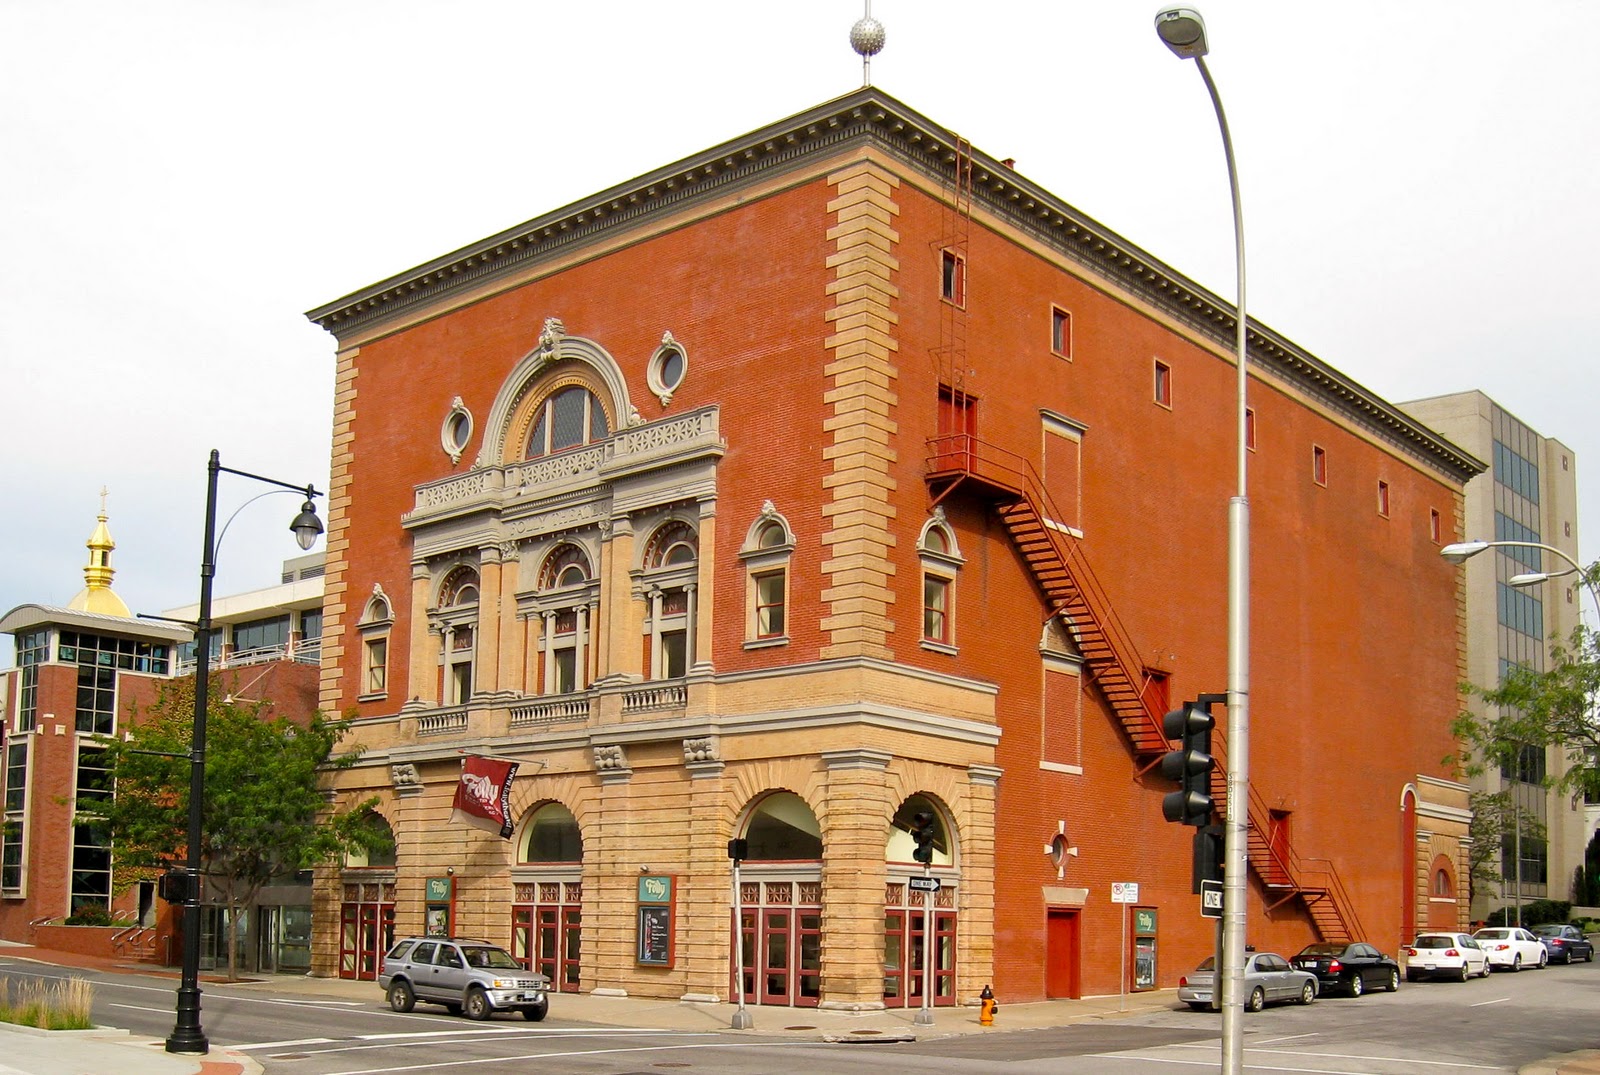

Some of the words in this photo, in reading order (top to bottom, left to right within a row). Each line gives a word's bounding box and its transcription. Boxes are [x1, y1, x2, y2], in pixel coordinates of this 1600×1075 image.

[509, 514, 547, 536] FOLLY
[551, 501, 609, 526] THEATER
[462, 773, 499, 805] Folly
[431, 880, 448, 898] Folly
[645, 878, 666, 899] Folly
[912, 880, 921, 888] ONE
[1205, 891, 1218, 907] ONE
